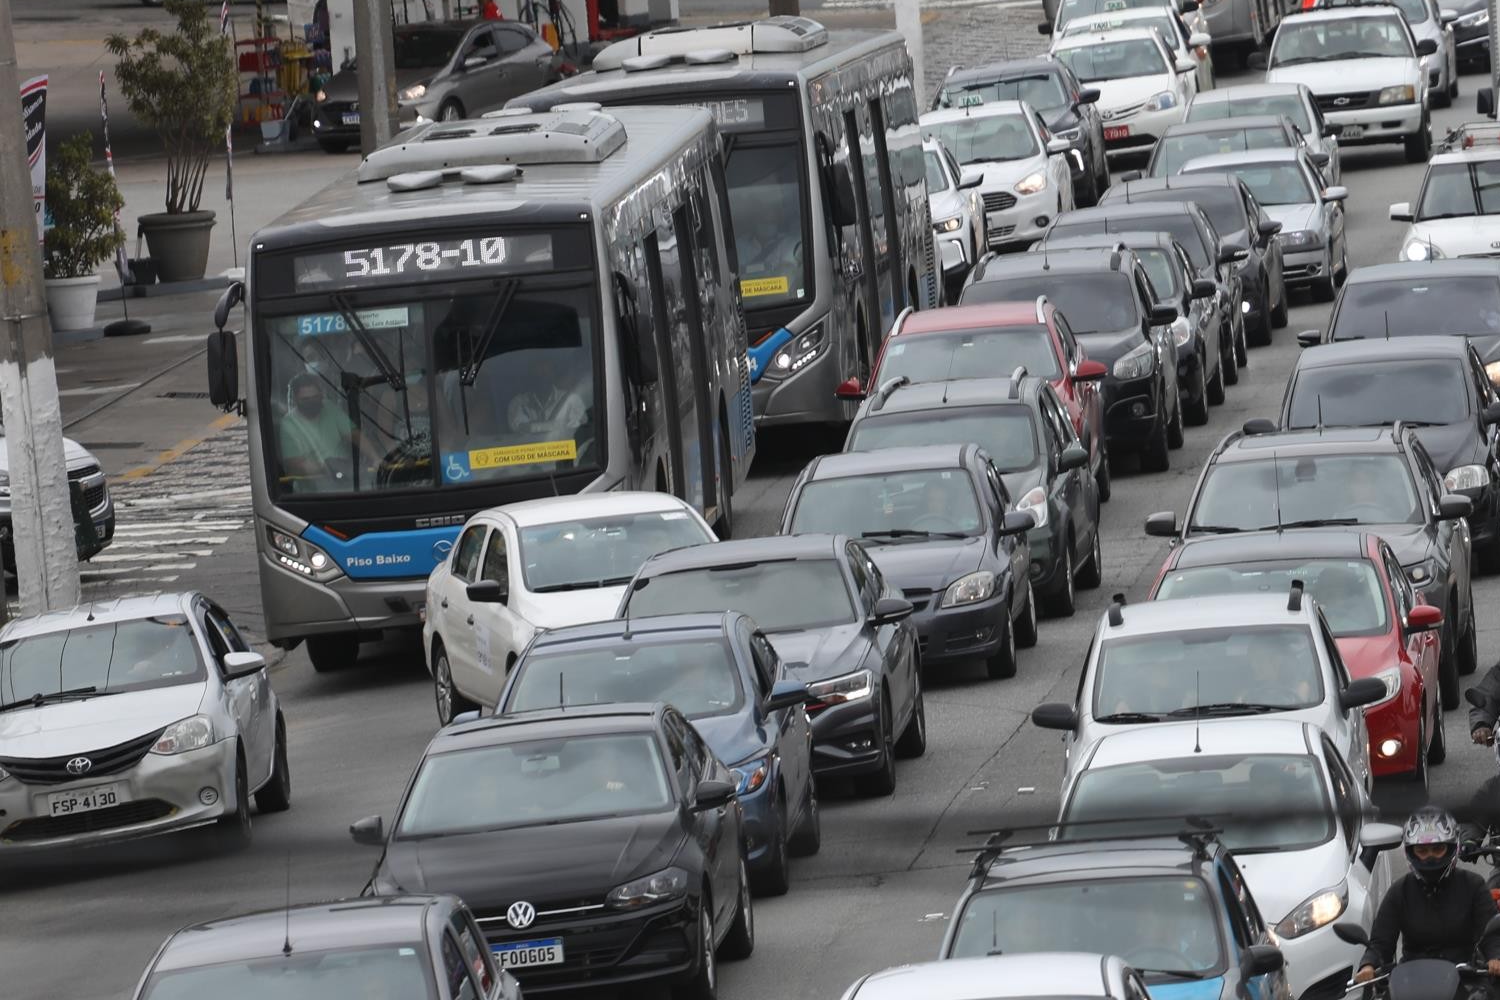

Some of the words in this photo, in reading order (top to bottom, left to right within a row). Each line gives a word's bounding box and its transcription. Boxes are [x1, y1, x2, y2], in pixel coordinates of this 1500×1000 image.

[343, 236, 507, 279] 5178-10
[346, 555, 373, 568] Piso
[376, 552, 412, 567] Baixo
